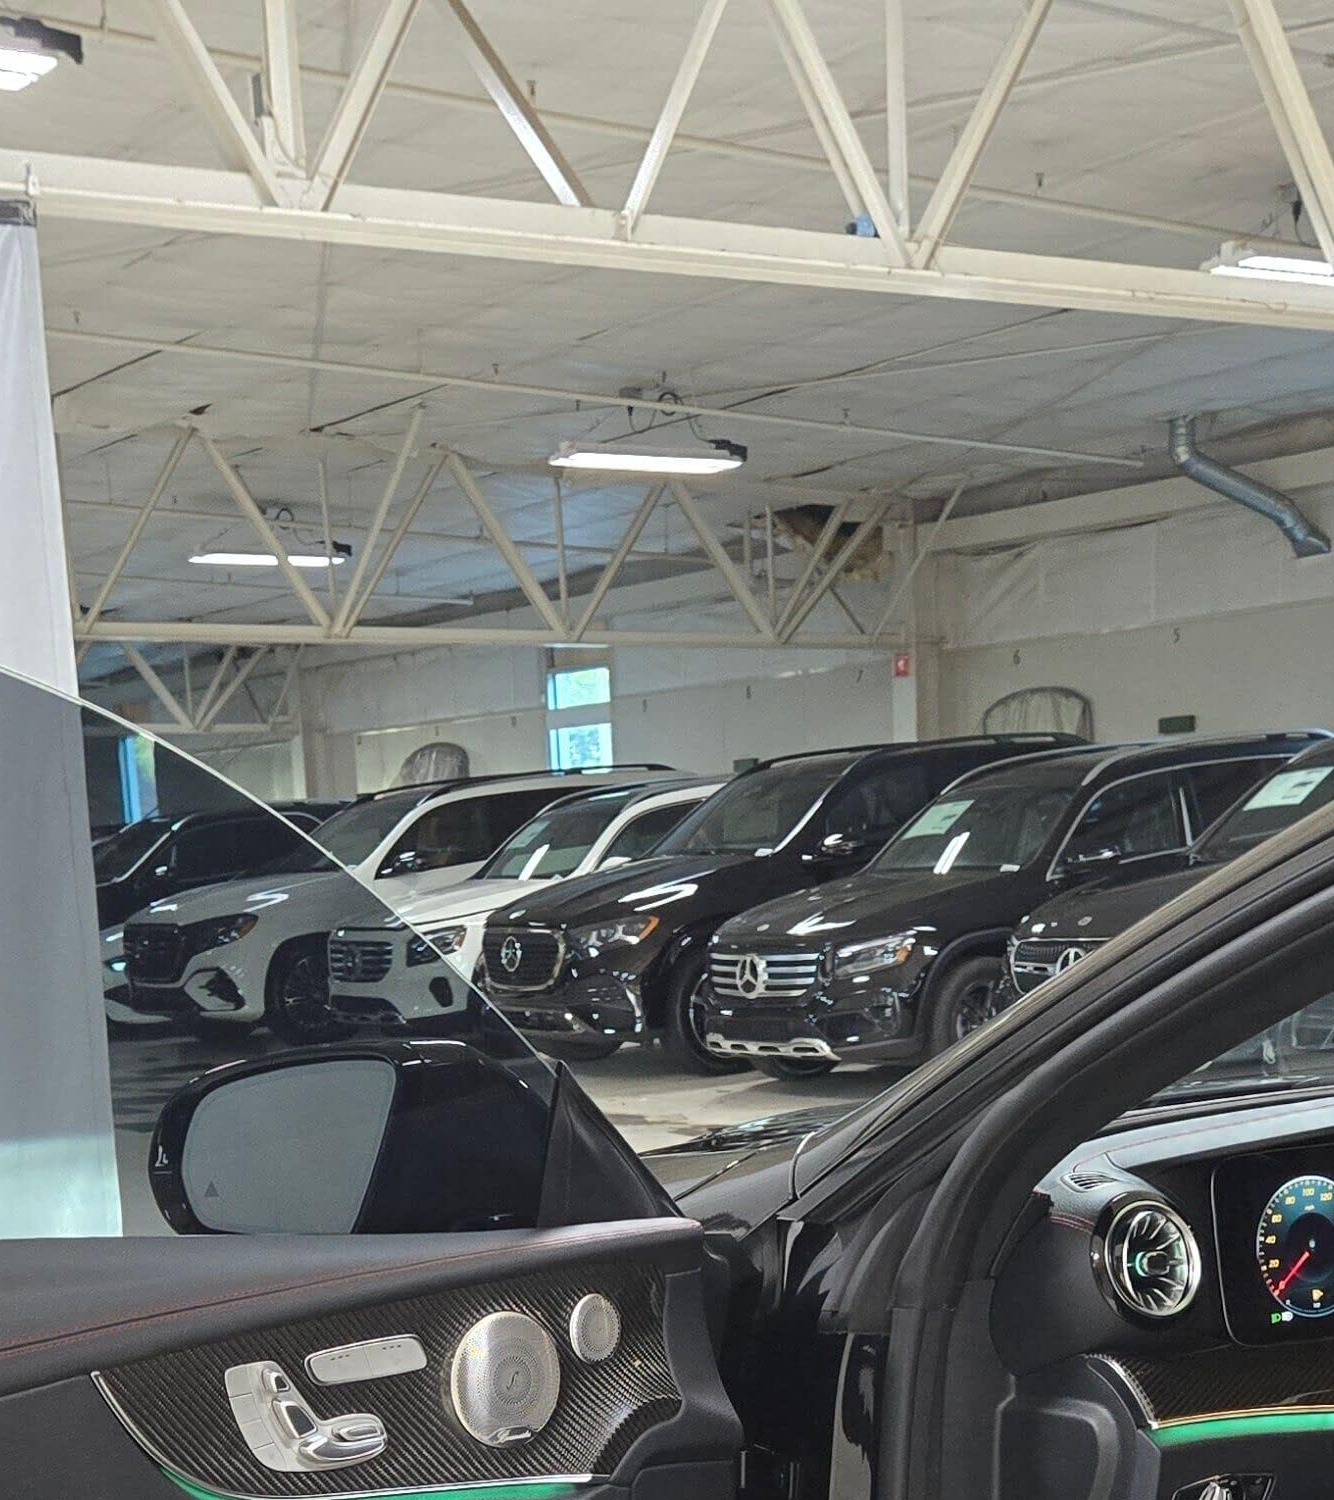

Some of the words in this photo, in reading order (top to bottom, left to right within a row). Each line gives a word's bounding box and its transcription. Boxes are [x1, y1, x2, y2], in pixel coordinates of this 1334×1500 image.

[1172, 626, 1181, 643] 5
[1012, 648, 1021, 665] 6
[1302, 1187, 1315, 1197] 100
[1319, 1191, 1333, 1202] 120
[1285, 1195, 1296, 1205] 80
[1271, 1213, 1283, 1224] 60
[1265, 1235, 1277, 1245] 40
[1268, 1258, 1280, 1269] 20
